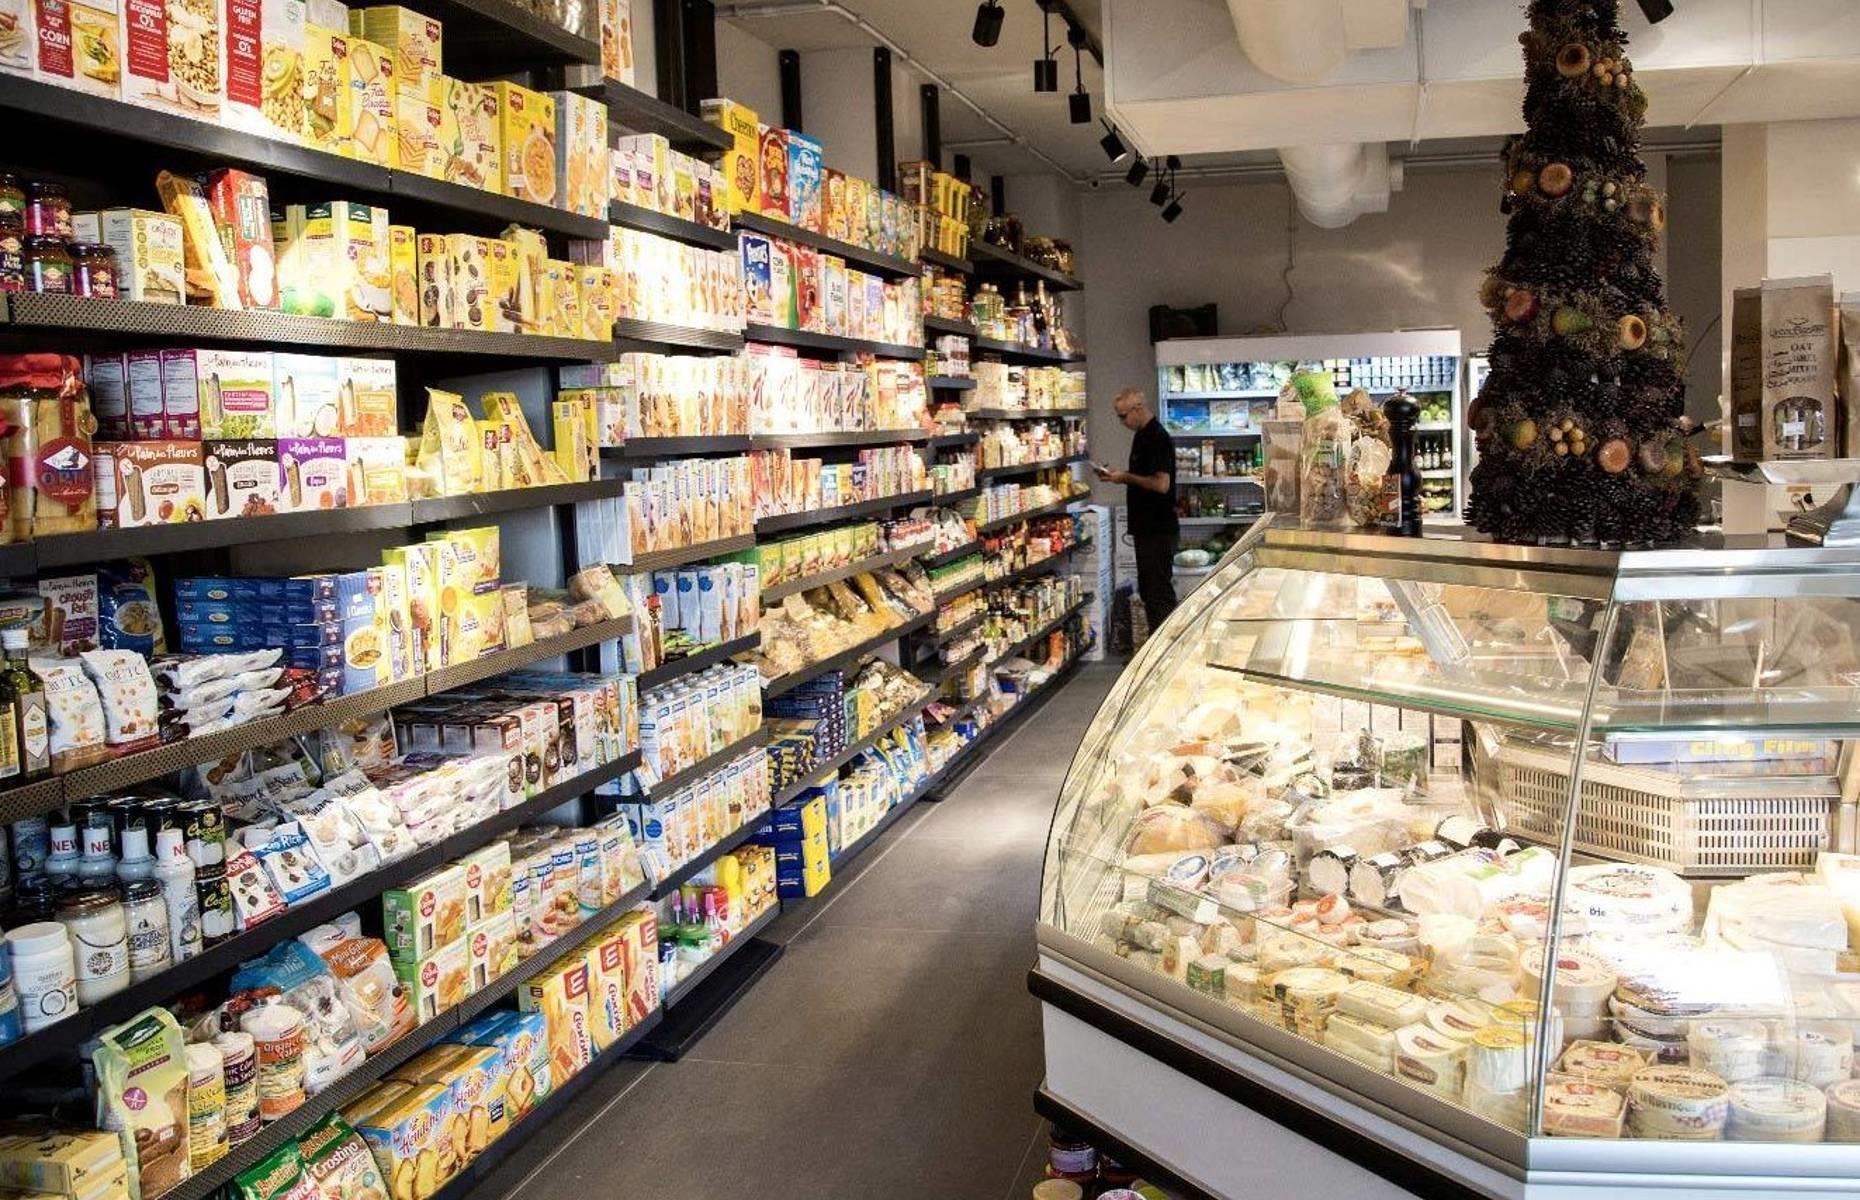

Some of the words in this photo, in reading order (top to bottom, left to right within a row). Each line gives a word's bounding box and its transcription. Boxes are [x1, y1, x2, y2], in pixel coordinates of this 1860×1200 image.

[39, 28, 71, 46] CORN
[1790, 342, 1814, 351] OAT
[166, 444, 197, 459] fleurs
[247, 443, 275, 456] fleurs
[90, 841, 110, 854] NE
[310, 1141, 360, 1178] Crostino
